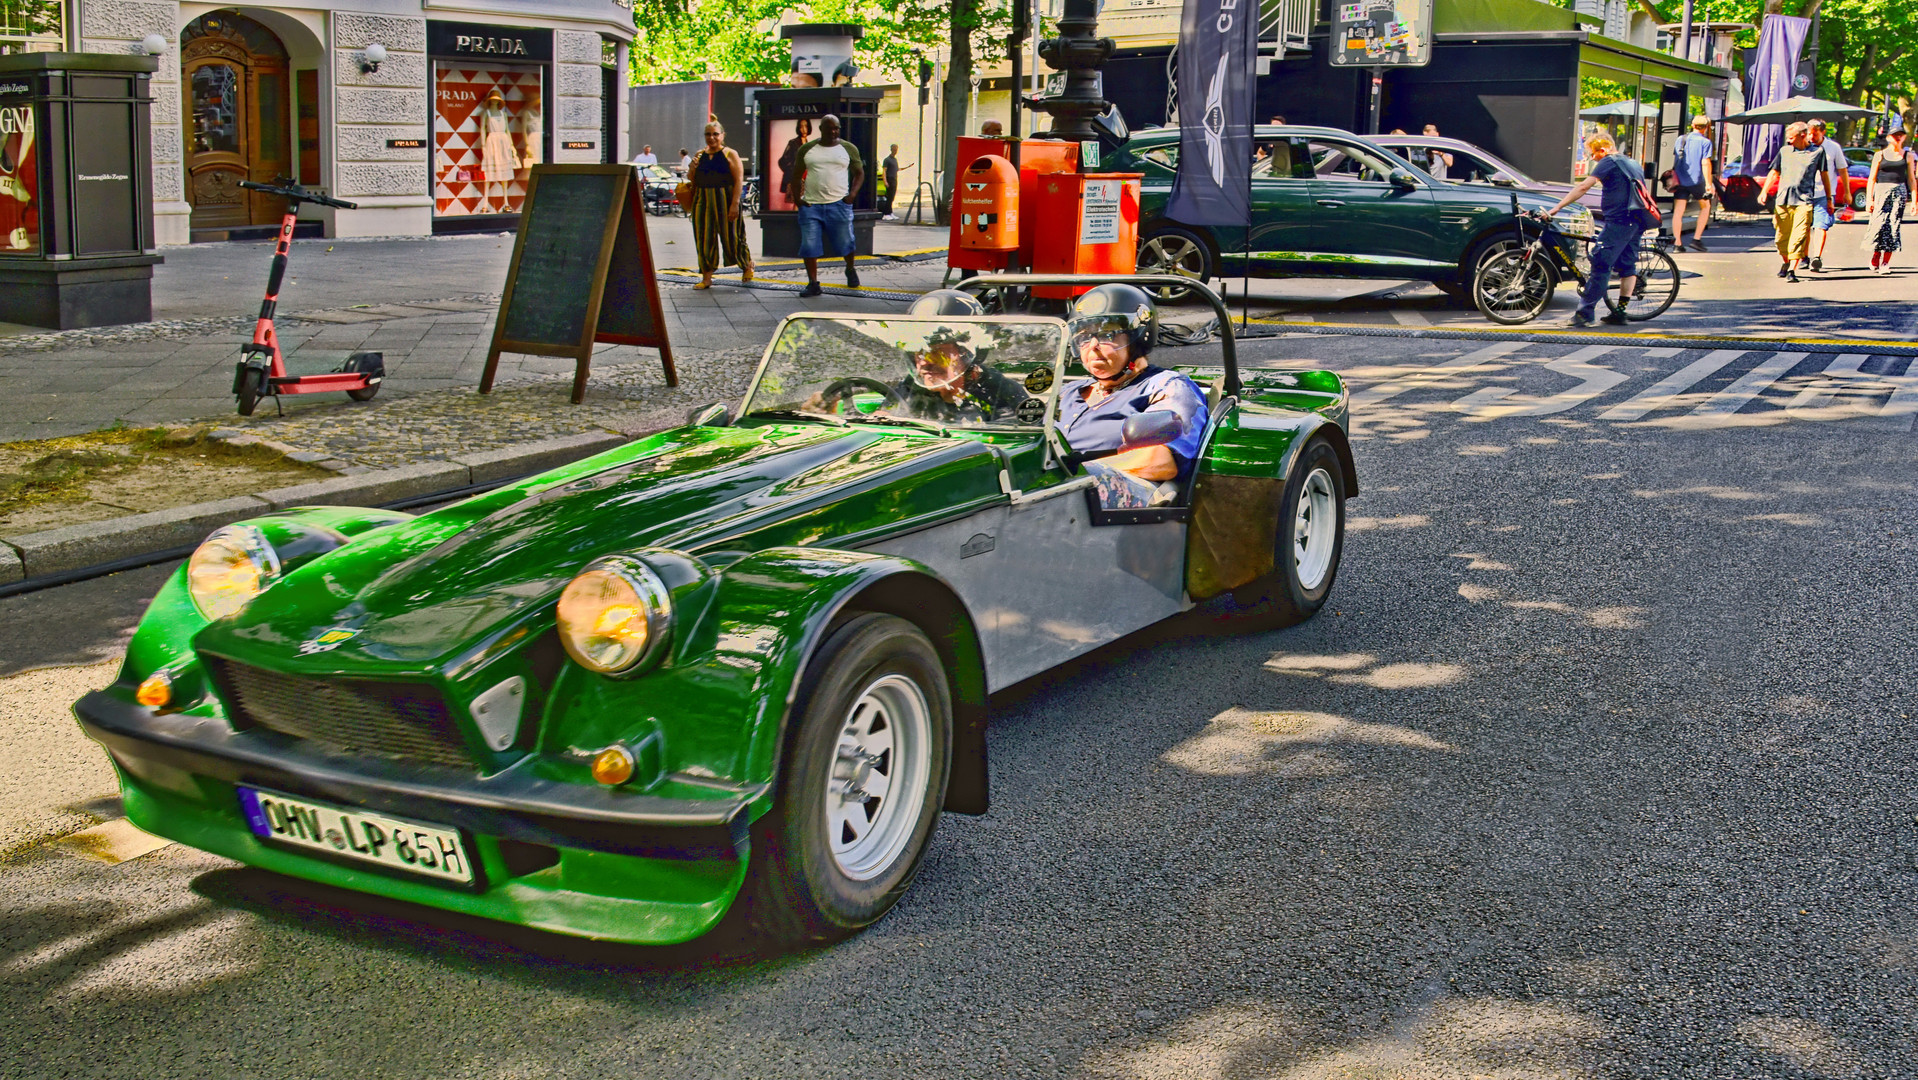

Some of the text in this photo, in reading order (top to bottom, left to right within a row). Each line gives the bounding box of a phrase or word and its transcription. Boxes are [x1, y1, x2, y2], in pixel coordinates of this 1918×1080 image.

[456, 35, 528, 55] PRADA
[436, 90, 477, 101] PRADA
[781, 104, 818, 114] PRADA
[340, 815, 388, 857] LP
